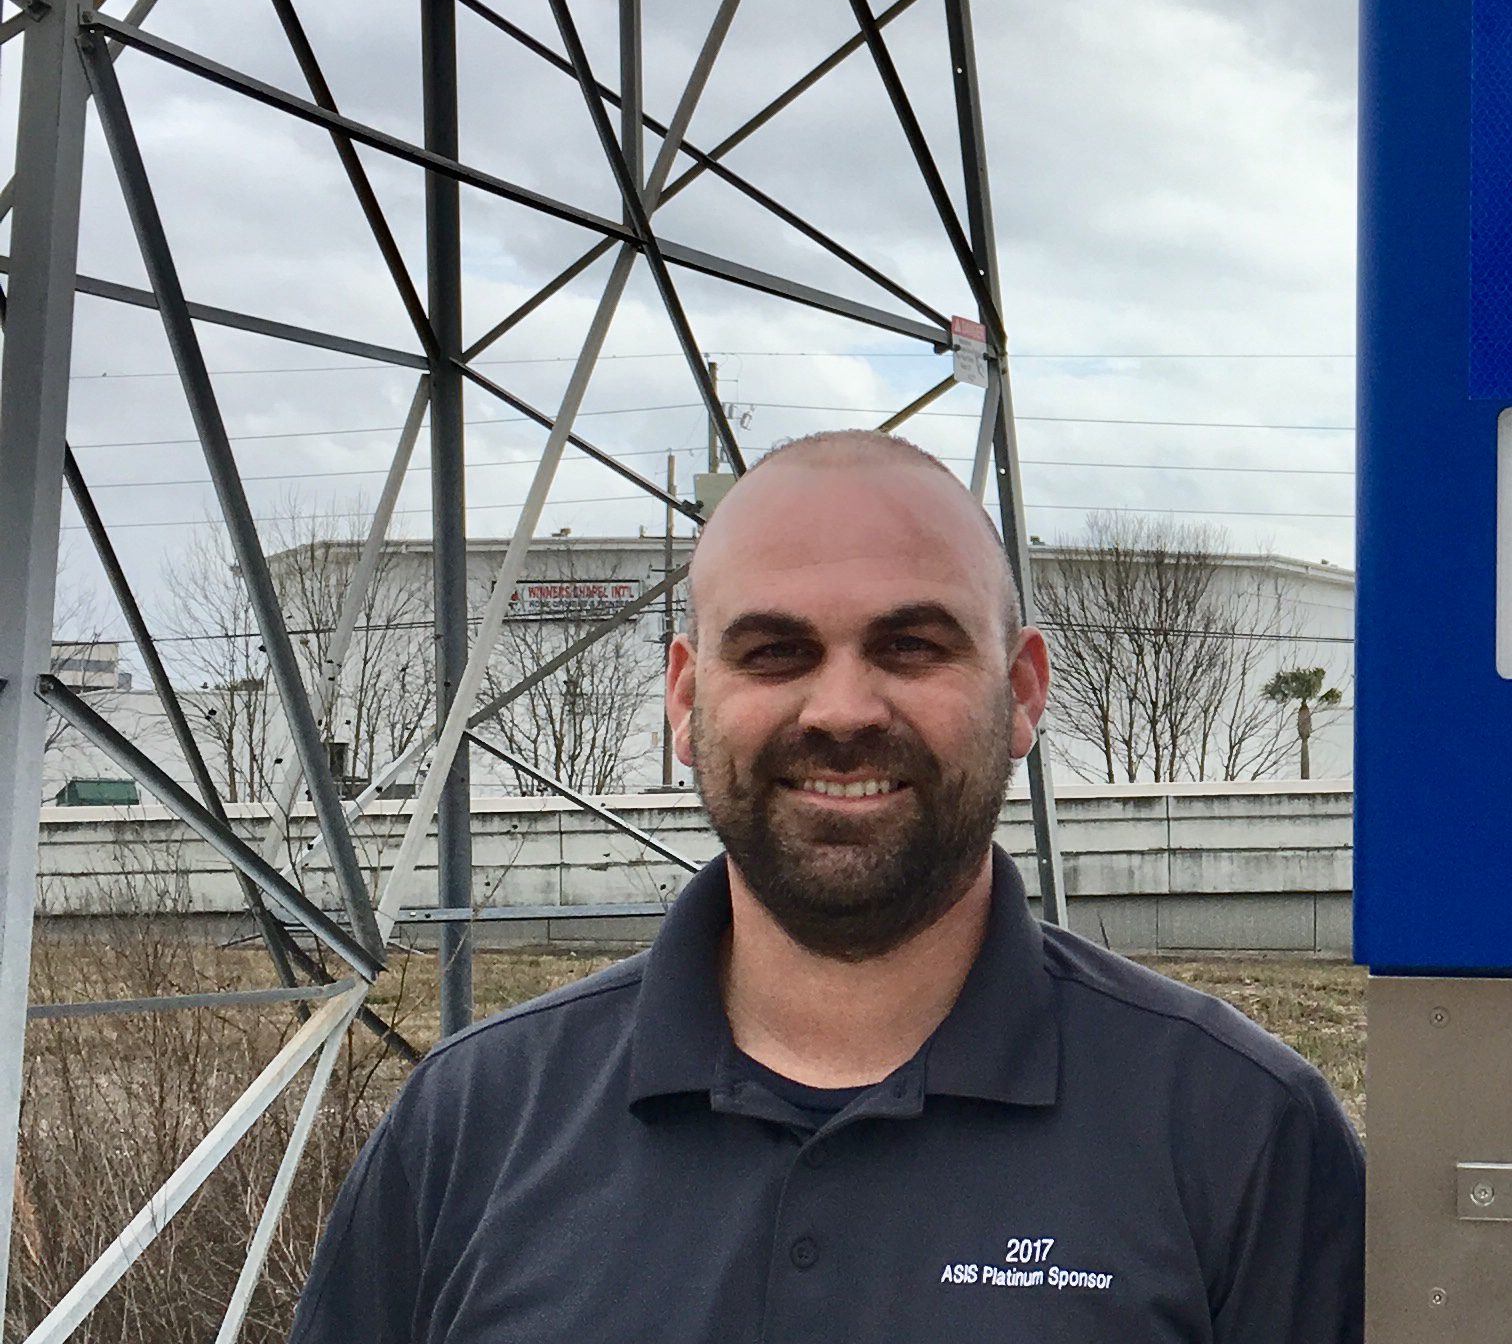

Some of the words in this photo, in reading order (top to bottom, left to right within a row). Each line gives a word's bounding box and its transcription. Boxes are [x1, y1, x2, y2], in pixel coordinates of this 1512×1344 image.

[1005, 1238, 1055, 1263] 2017
[940, 1264, 979, 1284] ASIS
[982, 1265, 1044, 1288] Platinum
[1048, 1266, 1114, 1290] Sponsor
